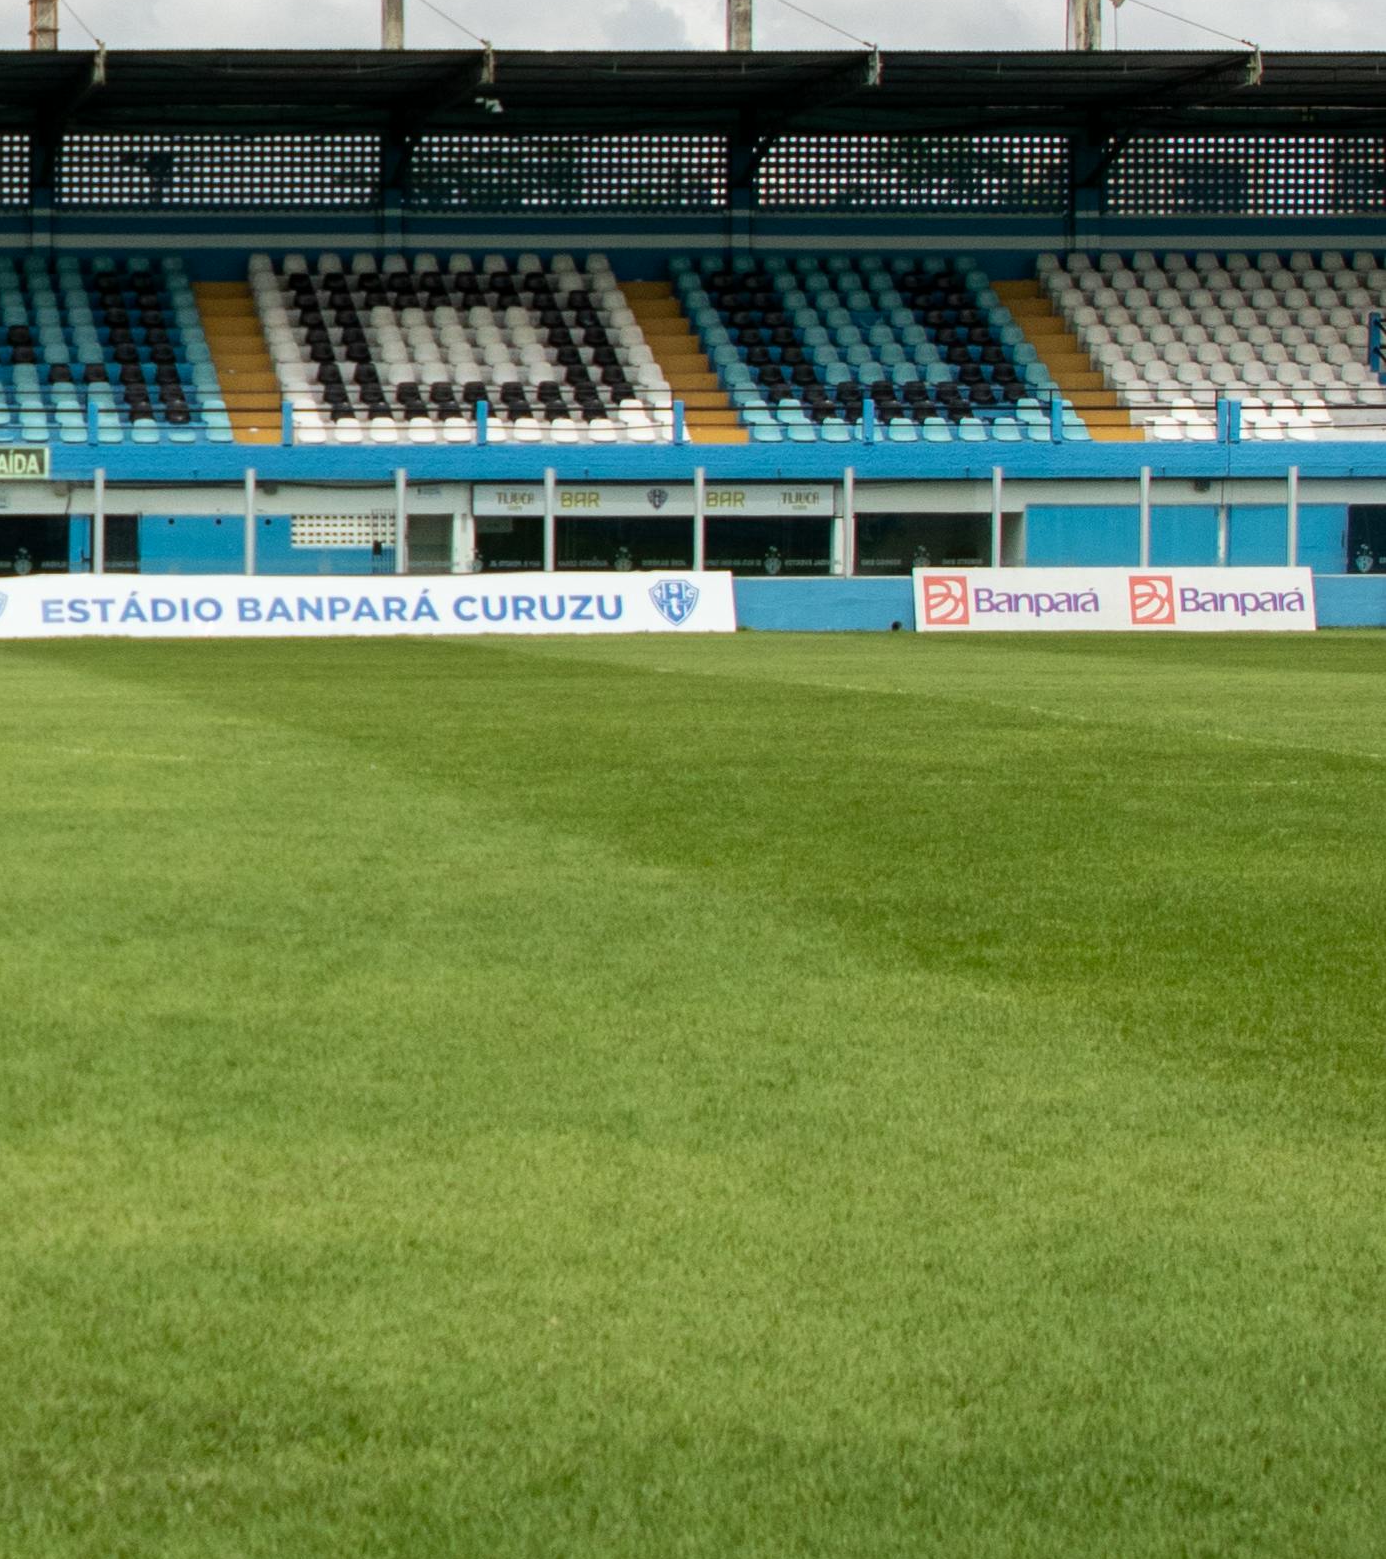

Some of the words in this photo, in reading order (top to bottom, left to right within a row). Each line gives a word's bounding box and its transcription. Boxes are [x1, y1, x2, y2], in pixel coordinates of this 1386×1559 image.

[560, 491, 600, 508] BAR
[705, 491, 746, 508] BAR
[41, 591, 223, 623] ESTÁDIO
[237, 588, 440, 622] BANPARÁ
[452, 593, 623, 621] CURUZU
[974, 587, 1100, 617] Banpará
[1179, 587, 1305, 617] Banpará
